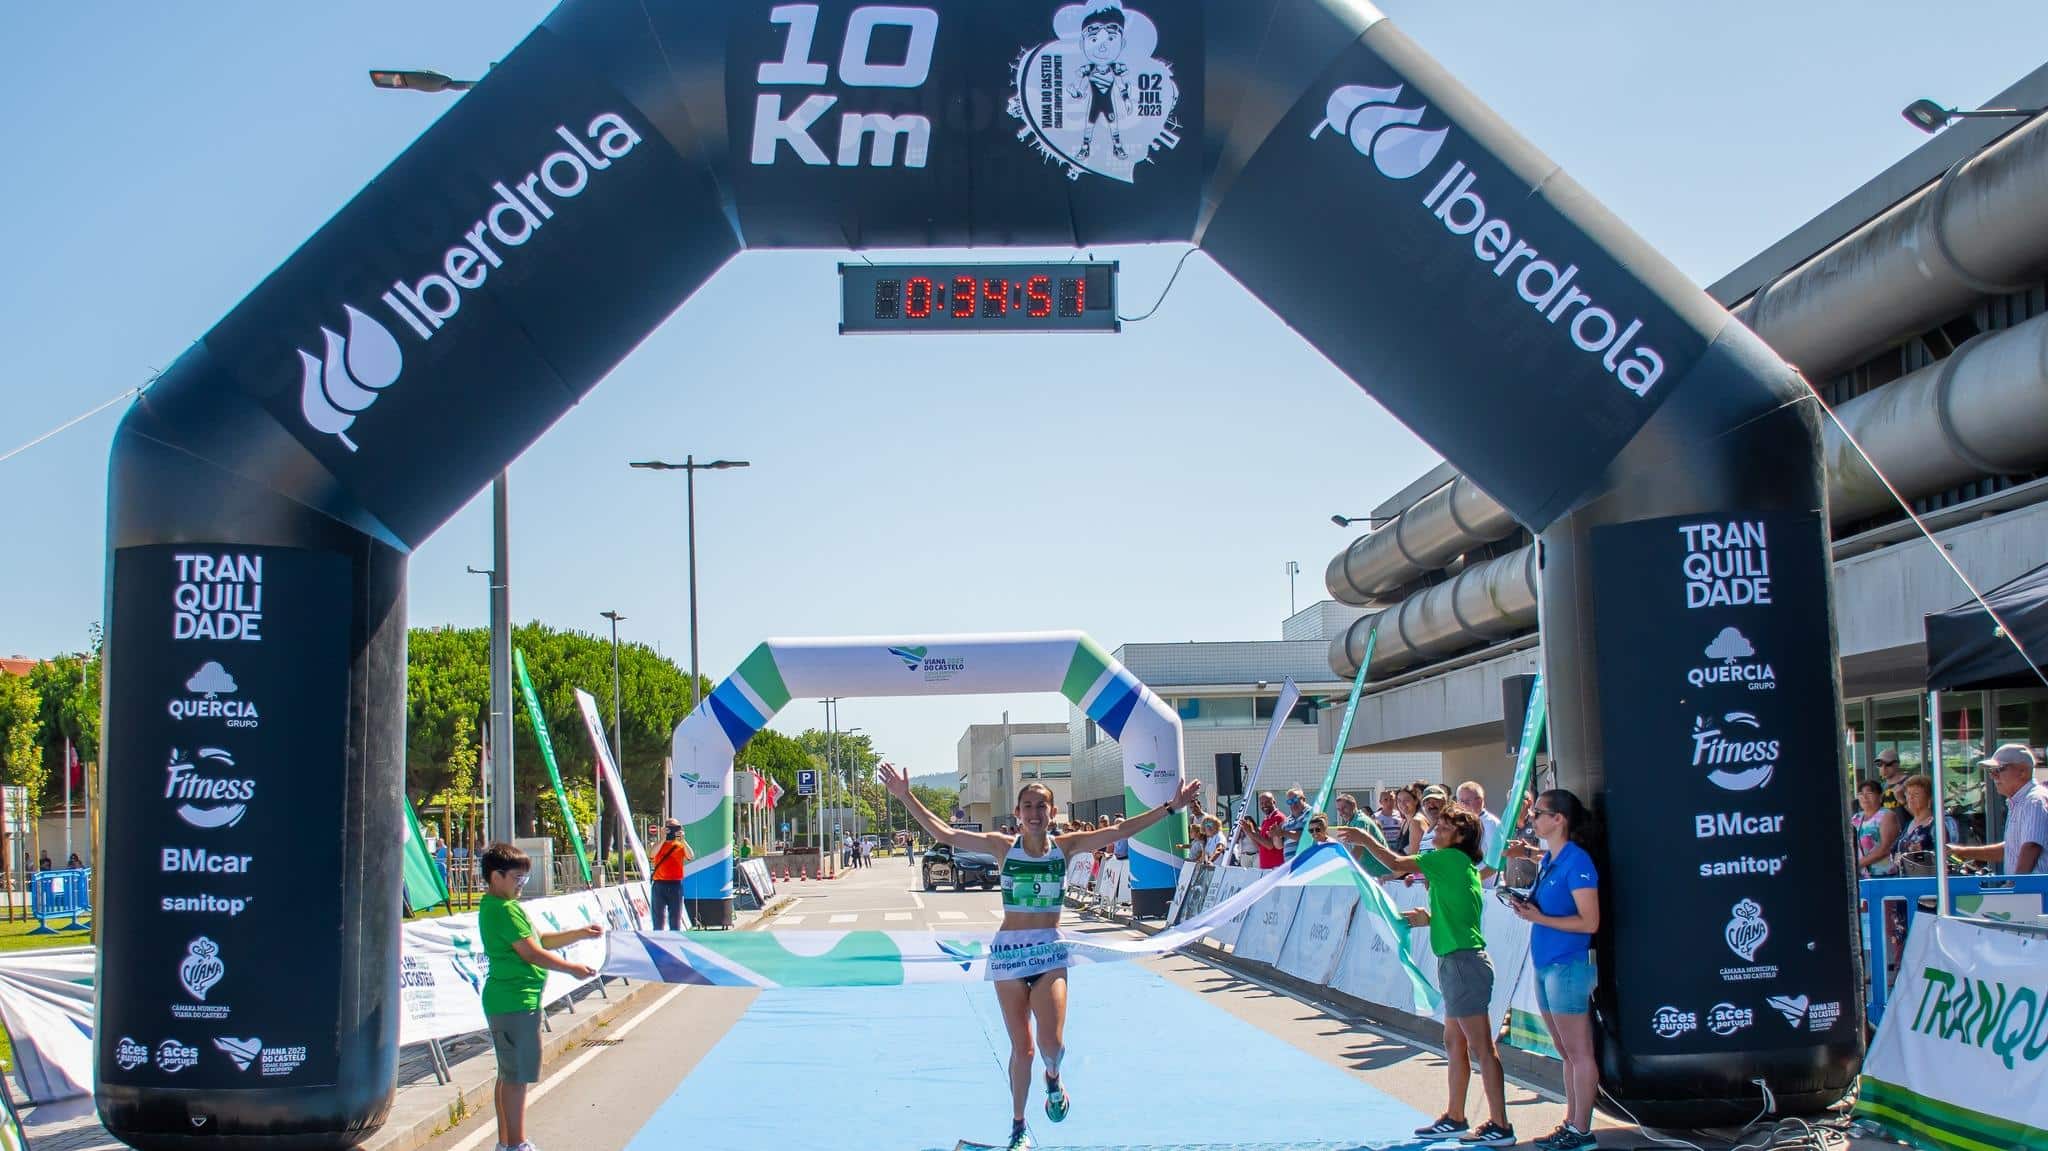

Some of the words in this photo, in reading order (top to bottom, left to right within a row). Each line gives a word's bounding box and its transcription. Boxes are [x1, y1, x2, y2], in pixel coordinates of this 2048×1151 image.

[758, 3, 939, 87] 10
[1041, 55, 1052, 89] CASTELO
[1138, 74, 1162, 90] 02
[1041, 91, 1052, 102] DO
[1138, 91, 1162, 104] JUL
[1041, 104, 1053, 128] VIANA
[1138, 104, 1162, 116] 2023
[750, 94, 932, 167] Km
[381, 112, 643, 341] Iberdrola
[1422, 160, 1664, 398] Iberdrola
[904, 276, 1086, 318] 0:34:51
[1678, 522, 1767, 551] TRAN
[174, 555, 263, 582] TRAN
[1683, 550, 1768, 583] QUILI
[175, 583, 262, 615] QUILI
[1686, 577, 1772, 609] DADE
[175, 612, 262, 640] DADE
[1688, 664, 1775, 688] QUERCIA
[1748, 681, 1775, 690] GRUPO
[168, 700, 259, 720] QUERCIA
[226, 720, 258, 728] GRUPO
[1692, 729, 1779, 766] Fitness
[165, 764, 256, 800] Fitness
[802, 773, 811, 784] P
[1695, 812, 1784, 838] BMcar
[161, 848, 252, 873] BMcar
[1699, 855, 1783, 877] sanitop
[1033, 882, 1041, 895] 9
[161, 894, 245, 916] sanitop
[991, 960, 1027, 971] European
[1029, 957, 1046, 967] City
[1660, 1012, 1696, 1023] aces
[1715, 1008, 1752, 1021] aces
[1716, 1017, 1753, 1029] portugal
[1660, 1022, 1697, 1032] europe
[121, 1045, 148, 1056] aces
[121, 1055, 148, 1064] europe
[163, 1047, 199, 1057] aces
[274, 1054, 306, 1062] CASTELO
[288, 1046, 306, 1054] 2023
[164, 1056, 198, 1066] portugal
